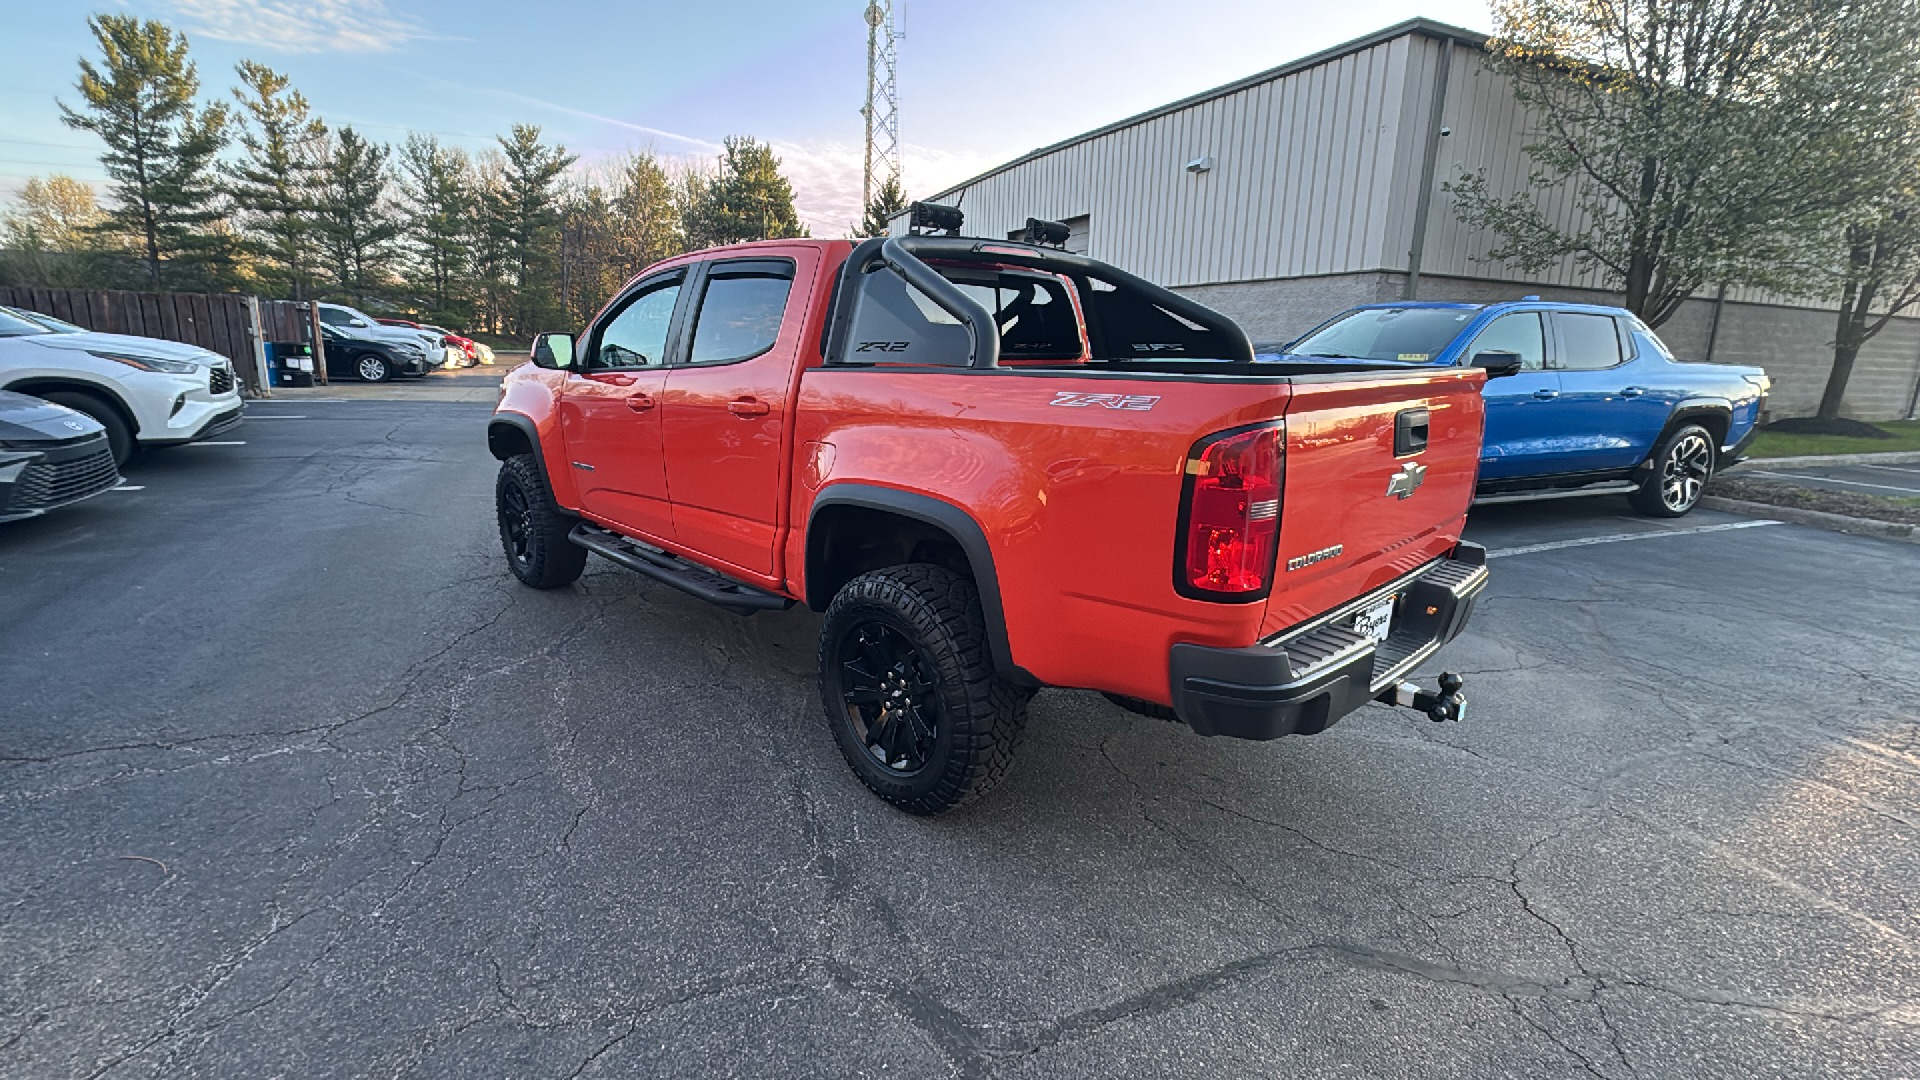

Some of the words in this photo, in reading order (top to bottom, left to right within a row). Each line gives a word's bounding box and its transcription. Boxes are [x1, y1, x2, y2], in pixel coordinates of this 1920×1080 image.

[856, 341, 910, 352] ZR2
[1049, 391, 1161, 411] ZR2
[1287, 543, 1343, 572] COLORADO
